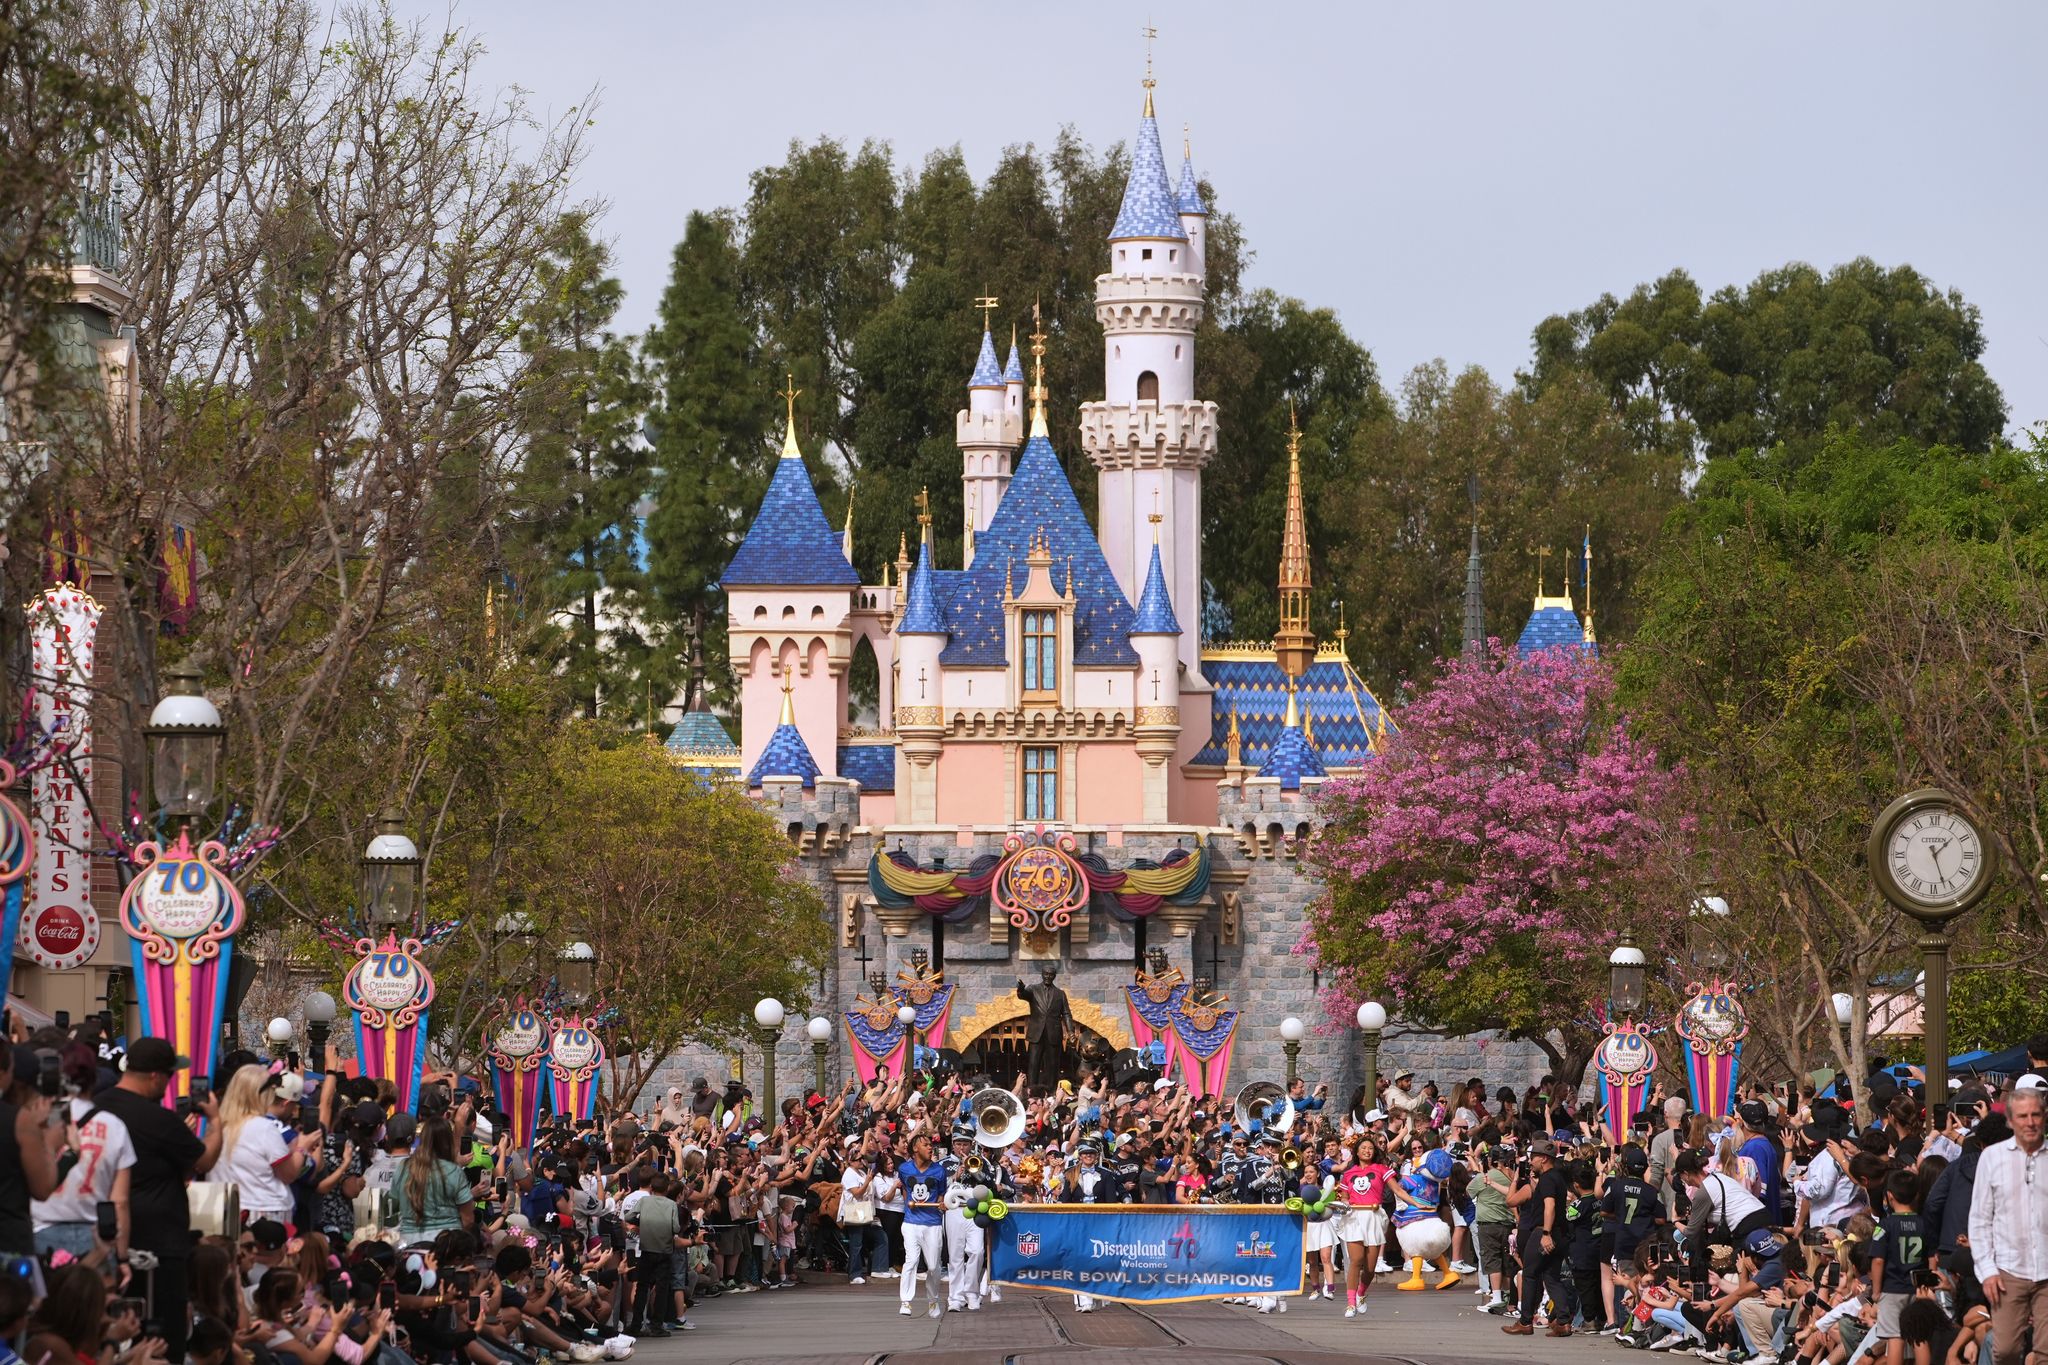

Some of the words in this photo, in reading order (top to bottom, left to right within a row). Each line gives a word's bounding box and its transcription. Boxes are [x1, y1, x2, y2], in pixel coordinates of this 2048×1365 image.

[49, 624, 75, 892] REREHMENTS
[157, 861, 208, 895] 70
[1019, 865, 1062, 892] 70
[371, 952, 411, 979] 70
[369, 981, 407, 991] CELEBRATE
[376, 989, 400, 998] HAPPY
[1701, 994, 1730, 1014] 70
[561, 1028, 588, 1047] 70
[1615, 1032, 1642, 1051] 70
[1624, 1185, 1641, 1195] SMITH
[1624, 1197, 1638, 1225] 7
[1020, 1243, 1038, 1255] NFL
[1089, 1238, 1167, 1260] Disneyland
[1168, 1237, 1200, 1260] 70
[1898, 1236, 1923, 1265] 12
[1120, 1259, 1168, 1269] Welcomes
[1017, 1269, 1074, 1281] SUPER
[1080, 1271, 1131, 1284] BOWL
[1138, 1273, 1160, 1284] LX
[1164, 1273, 1275, 1288] CHAMPIONS
